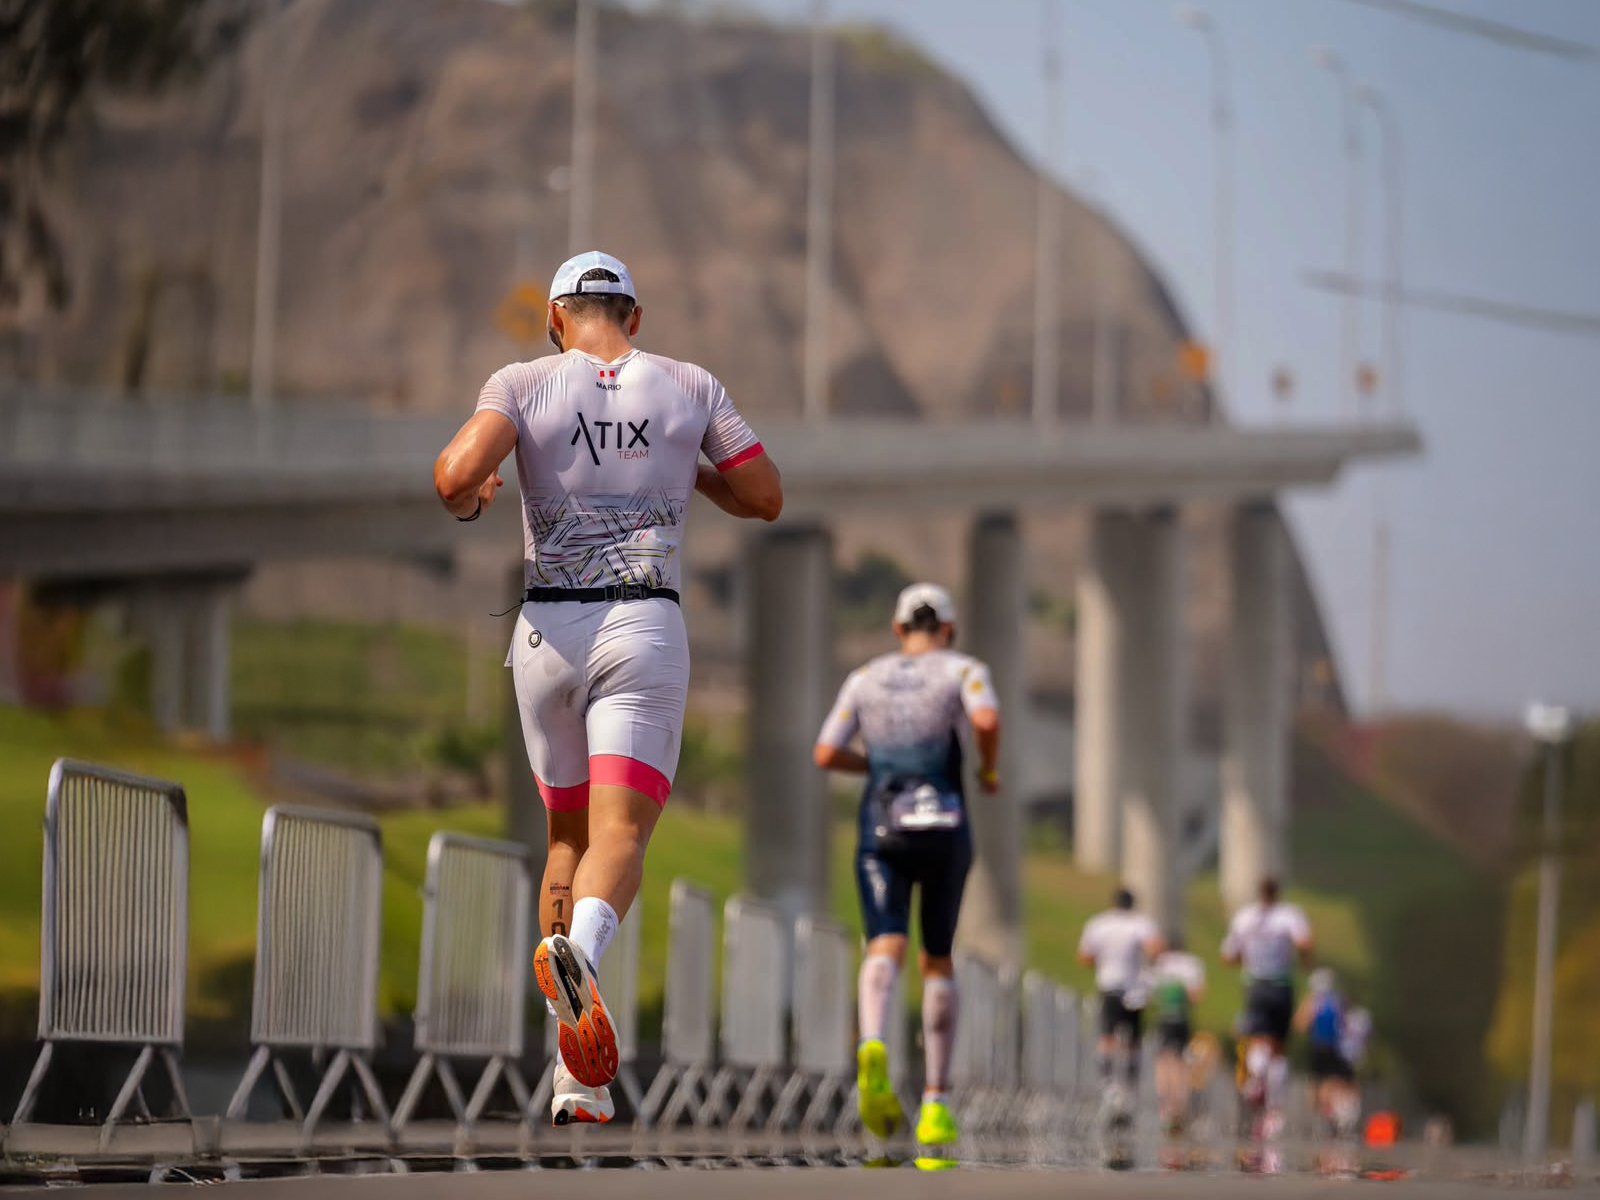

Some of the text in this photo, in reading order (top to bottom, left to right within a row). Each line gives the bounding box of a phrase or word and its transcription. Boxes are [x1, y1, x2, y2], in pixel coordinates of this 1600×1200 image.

[596, 381, 622, 391] MARIO
[571, 412, 649, 465] ATIX
[617, 450, 649, 460] TEAM
